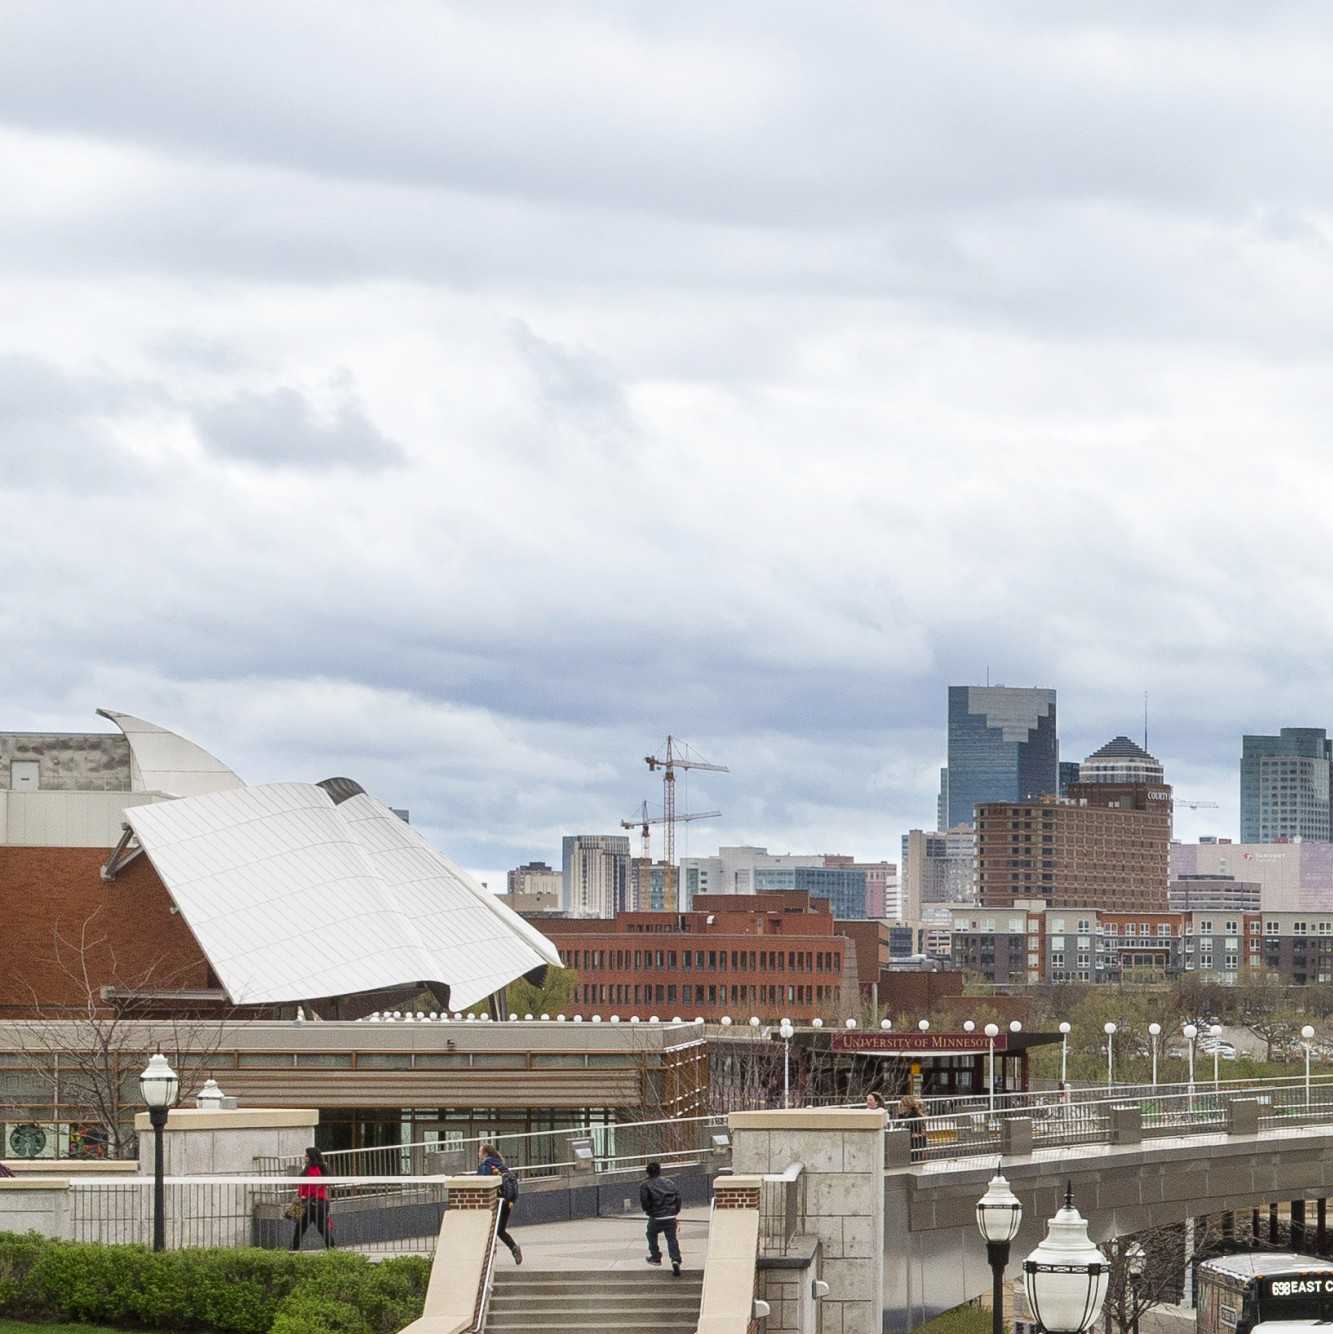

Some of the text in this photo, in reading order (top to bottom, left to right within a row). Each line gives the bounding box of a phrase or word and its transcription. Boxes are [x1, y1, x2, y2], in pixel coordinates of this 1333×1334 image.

[843, 1036, 911, 1048] UNIVERSITY
[914, 1037, 928, 1048] OF
[1291, 1280, 1322, 1293] EAST
